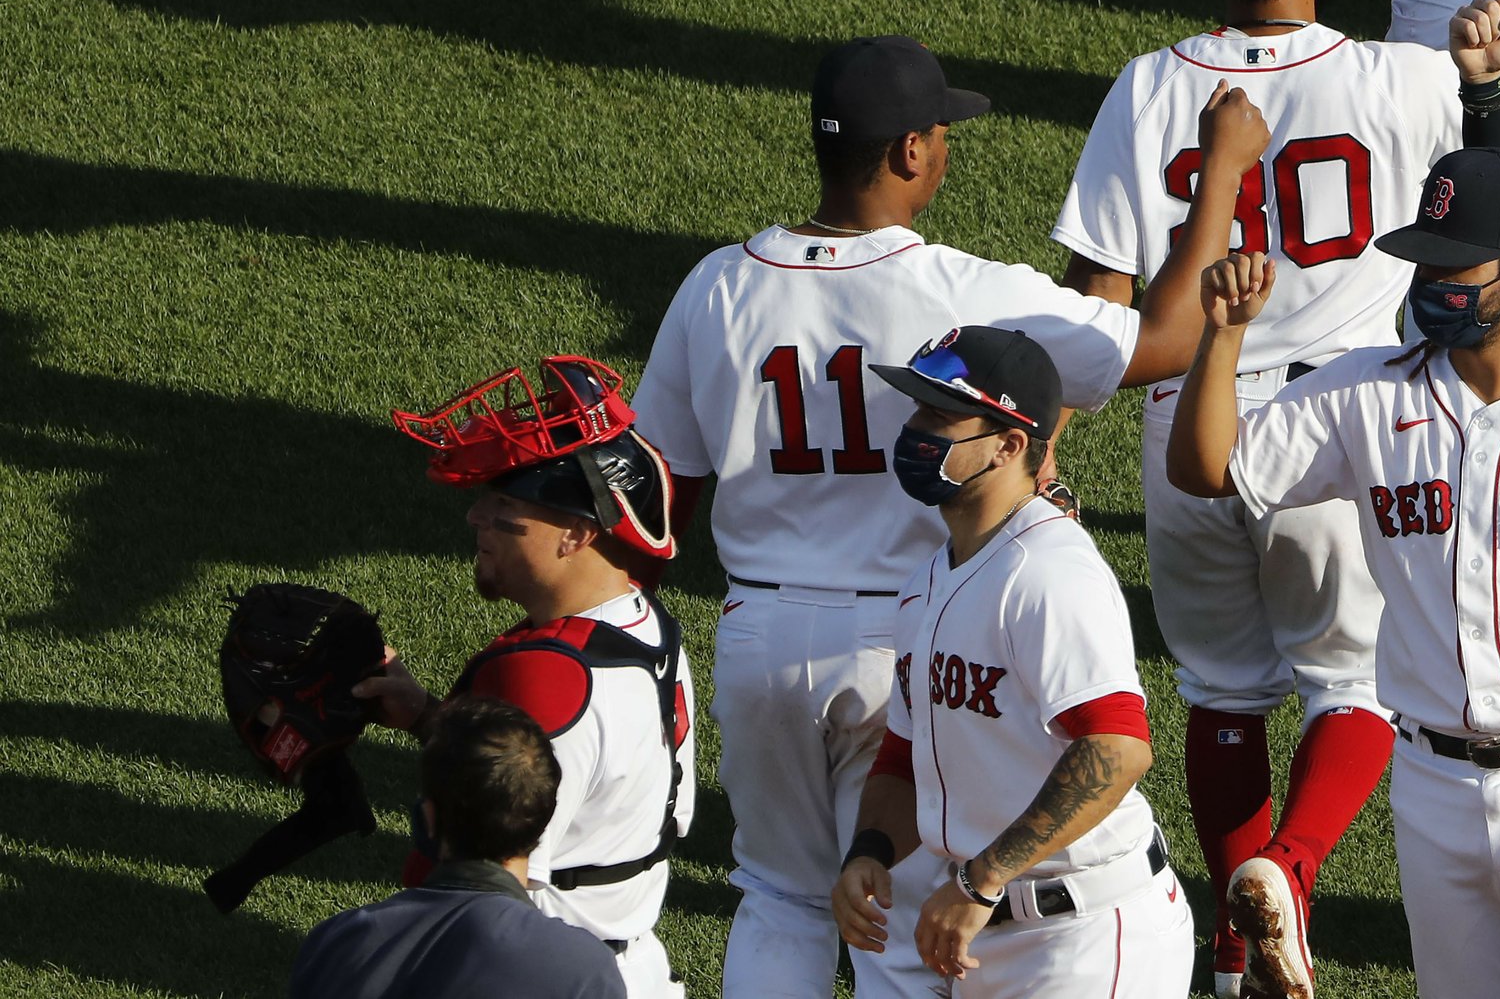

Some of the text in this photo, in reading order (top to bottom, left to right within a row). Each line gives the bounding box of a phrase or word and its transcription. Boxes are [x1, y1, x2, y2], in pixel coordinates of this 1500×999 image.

[1425, 176, 1456, 220] B
[1444, 293, 1468, 309] 36
[760, 345, 888, 475] 11
[1369, 478, 1455, 538] RED
[930, 650, 1008, 719] SOX
